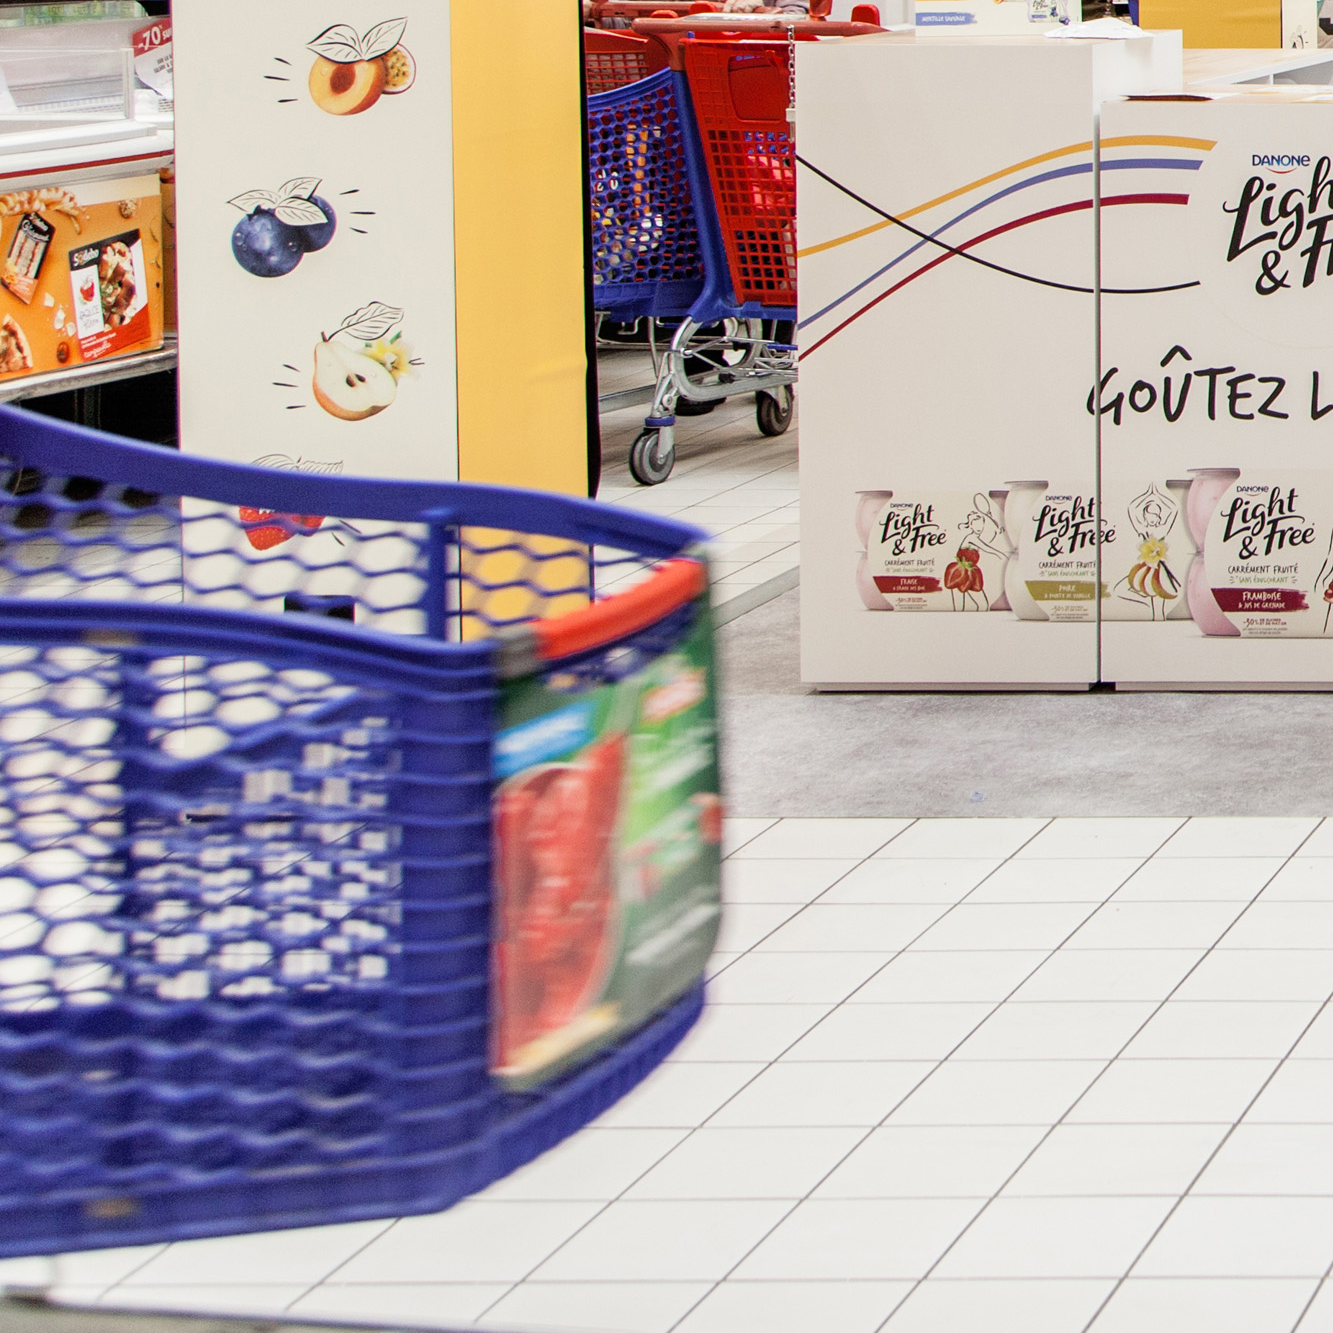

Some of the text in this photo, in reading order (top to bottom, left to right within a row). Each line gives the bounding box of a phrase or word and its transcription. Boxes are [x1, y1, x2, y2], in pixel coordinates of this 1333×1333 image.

[1252, 155, 1310, 166] DANONE
[1255, 250, 1292, 296] &
[1086, 345, 1288, 425] GOÛTEZ
[879, 504, 935, 544] Light
[1032, 496, 1095, 543] Light
[1221, 487, 1299, 543] Light
[892, 524, 947, 556] & Free
[1048, 518, 1116, 557] & Free
[1239, 516, 1315, 560] & Free
[1242, 591, 1281, 600] FRAMBOISE
